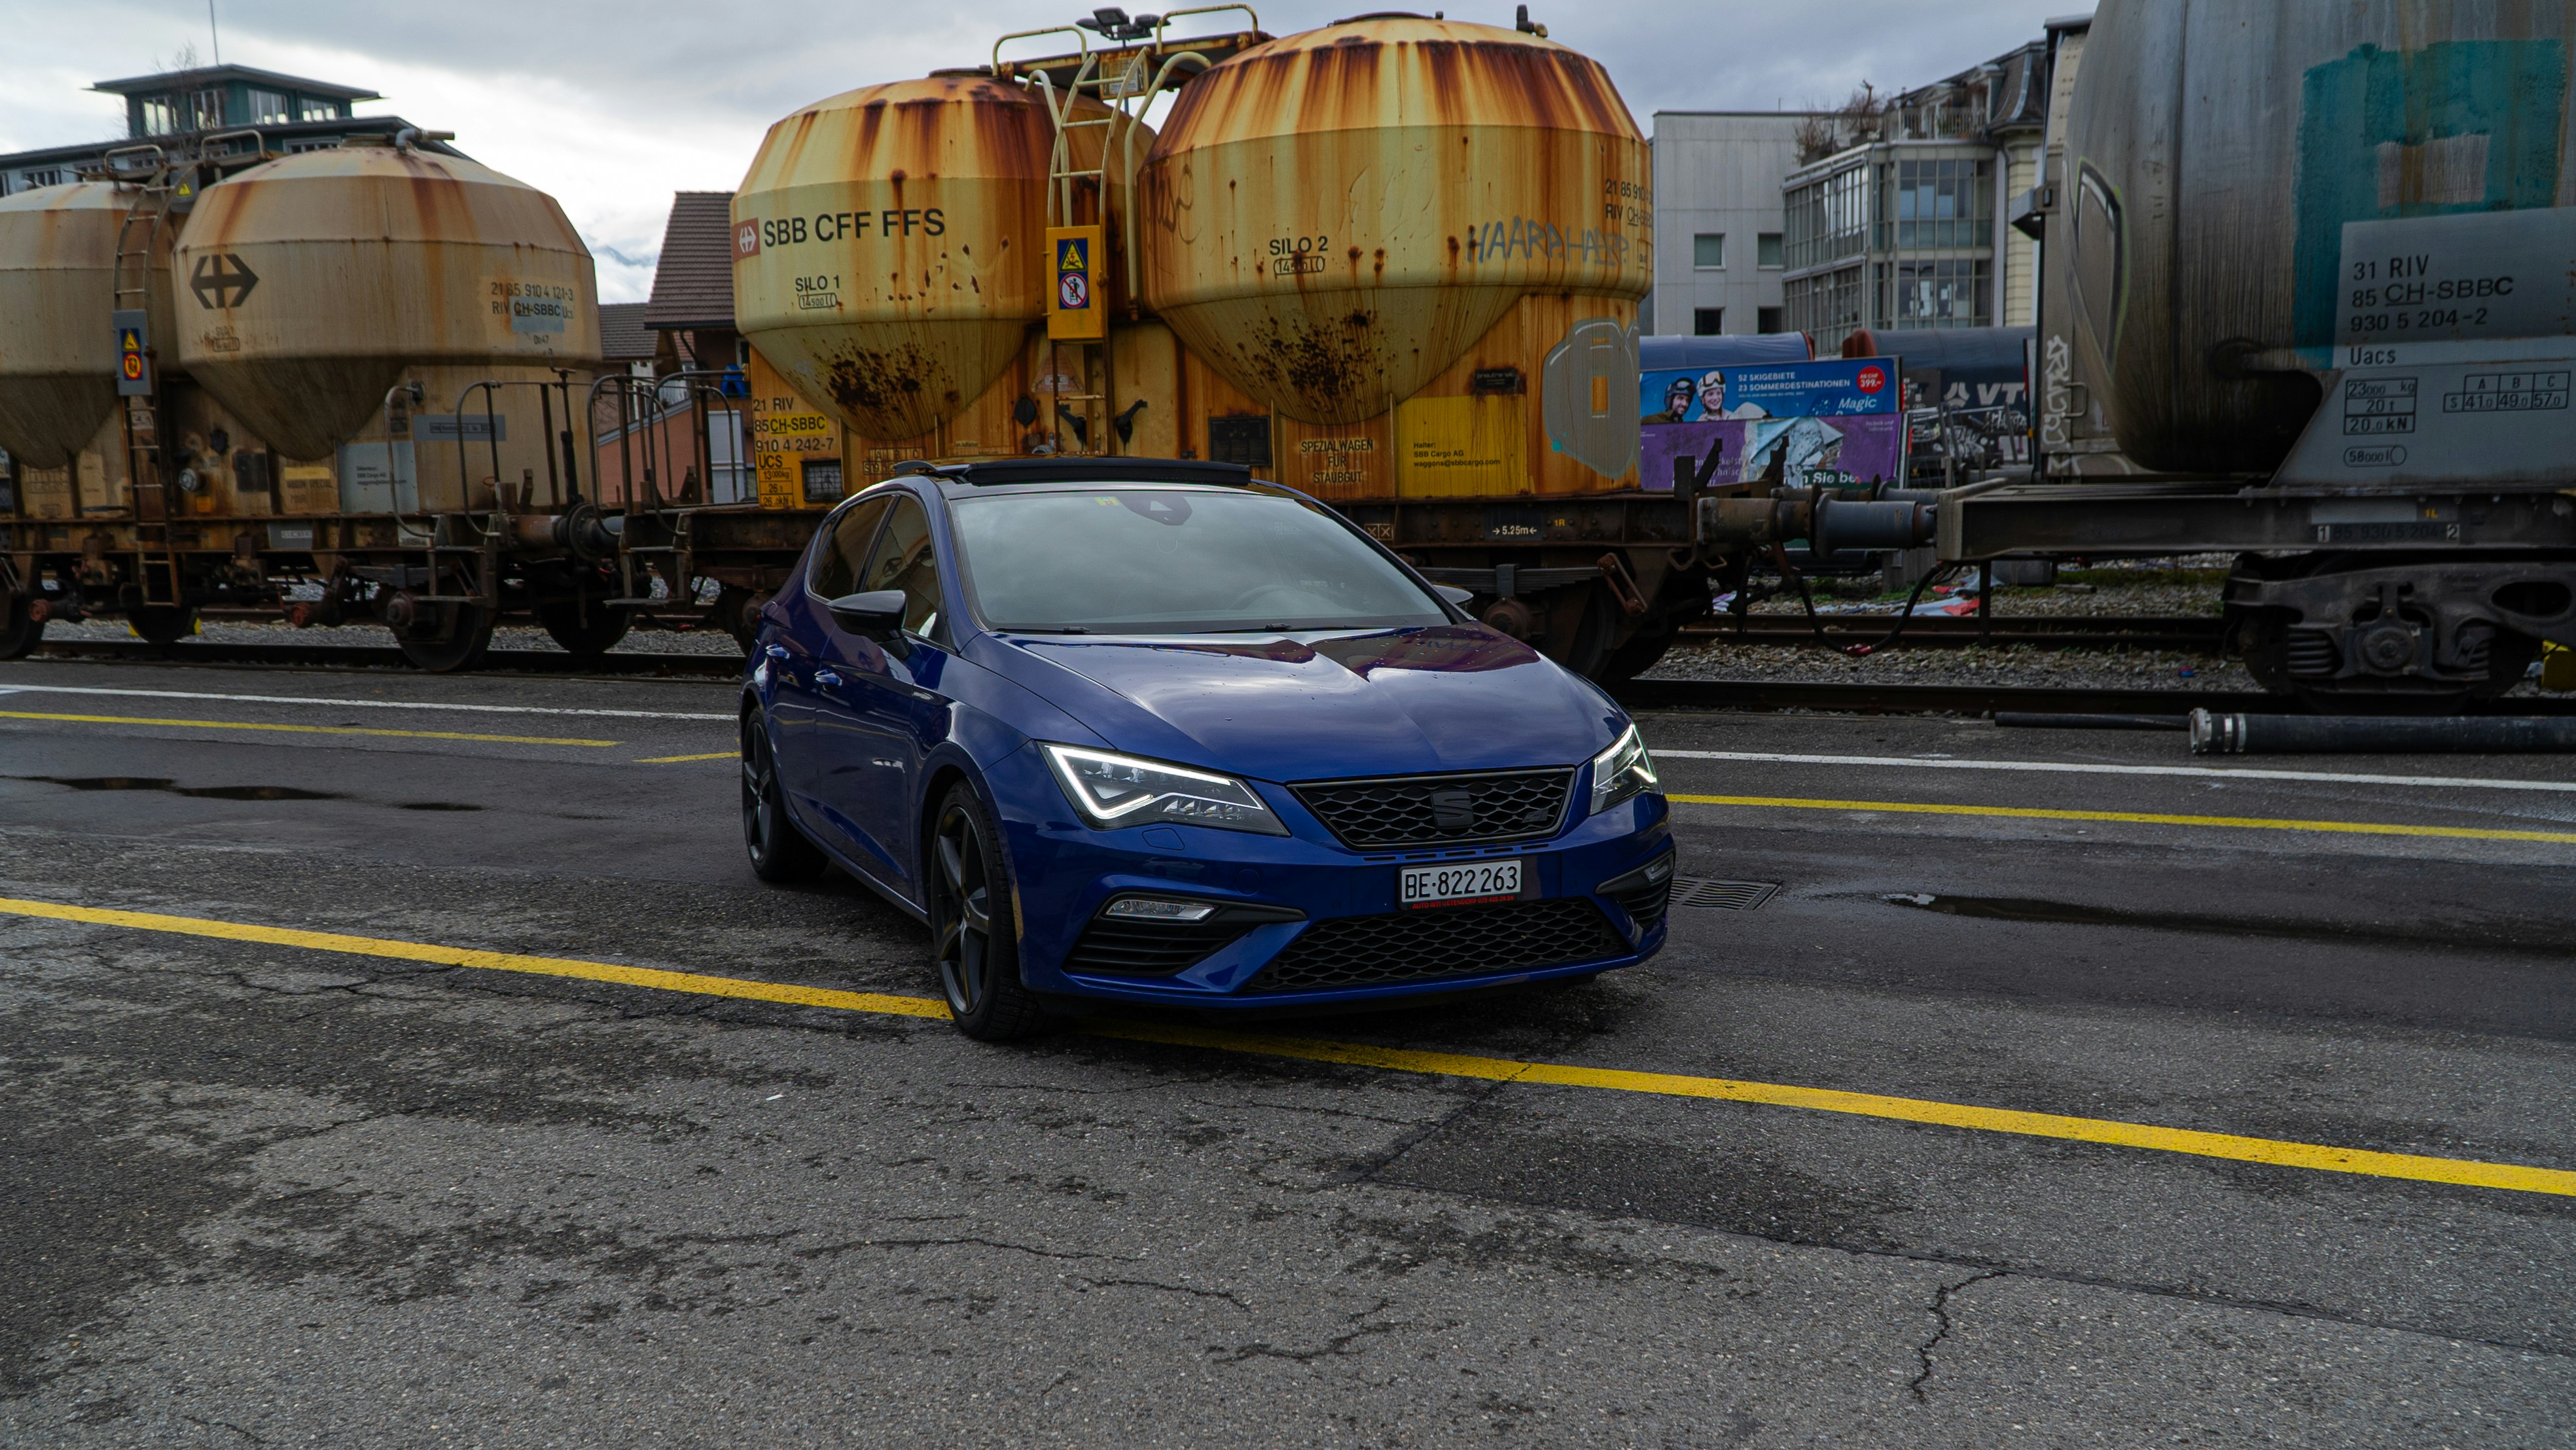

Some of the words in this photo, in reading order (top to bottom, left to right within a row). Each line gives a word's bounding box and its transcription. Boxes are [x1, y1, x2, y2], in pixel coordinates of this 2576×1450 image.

[1605, 179, 1617, 196] 21
[1621, 181, 1632, 198] 85
[1633, 184, 1645, 201] 910
[1605, 203, 1624, 220] RIV
[764, 217, 808, 247] SBB
[815, 211, 871, 241] CFF
[882, 208, 945, 237] FFS
[1270, 237, 1312, 255] SILO
[1318, 236, 1328, 251] 2
[2353, 261, 2376, 281] 31
[2389, 254, 2429, 279] RIV
[492, 282, 503, 295] 21
[525, 284, 542, 298] 910
[544, 286, 550, 298] 4
[795, 275, 828, 292] SILO
[833, 275, 840, 289] 1
[2352, 289, 2377, 308] 85
[2385, 276, 2514, 306] CH-SBBC
[492, 301, 510, 314] RIV
[514, 302, 561, 317] CH-SBBC
[2350, 314, 2389, 332] 930
[2397, 312, 2409, 329] 5
[2418, 308, 2488, 328] 204-2
[2350, 347, 2396, 365] Uacs
[1749, 372, 1795, 381] SKIGEBIETE
[2478, 378, 2486, 389] A
[2513, 377, 2520, 388] B
[2547, 376, 2555, 387] C
[1749, 380, 1850, 391] SOMMERDESTINATIONEN
[2348, 383, 2386, 397] 23000
[2401, 381, 2415, 395] kg
[1977, 382, 2026, 405] VT
[753, 399, 766, 411] 21
[773, 397, 794, 410] RIV
[1838, 396, 1877, 412] Magic
[2366, 400, 2385, 413] 20
[2389, 400, 2395, 412] t
[2450, 397, 2457, 408] S
[755, 419, 769, 432] 85
[770, 416, 825, 434] CH-SBBC
[2386, 417, 2407, 431] kN
[756, 439, 779, 452] 910
[783, 439, 791, 451] 4
[796, 438, 833, 451] 242-7
[1302, 439, 1373, 452] SPEZIALWAGEN
[759, 454, 782, 469] UCS
[1414, 459, 1501, 468] waggons@sbbcargo.com
[1314, 471, 1361, 484] STAUBGUT
[1813, 472, 1835, 484] Sie
[768, 483, 778, 493] 26
[1502, 525, 1529, 535] 5.25m
